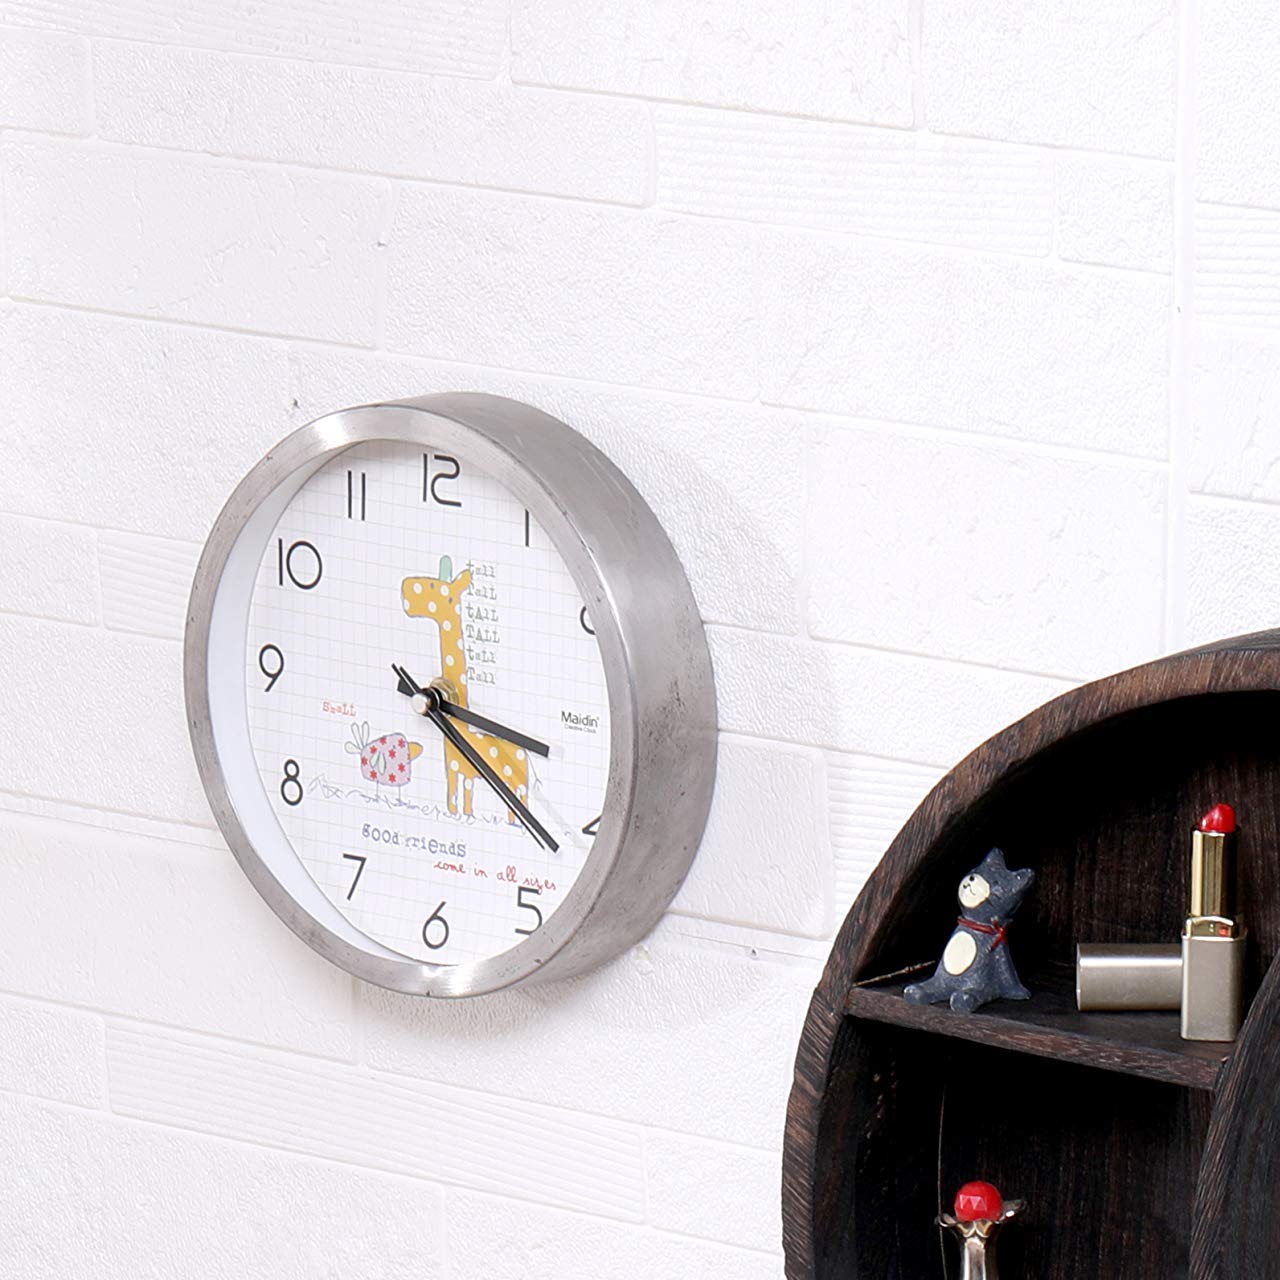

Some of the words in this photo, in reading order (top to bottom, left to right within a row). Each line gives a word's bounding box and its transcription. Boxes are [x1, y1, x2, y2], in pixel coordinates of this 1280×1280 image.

[347, 470, 366, 521] 11
[422, 453, 462, 507] 12
[278, 538, 323, 590] 10
[259, 644, 285, 692] 9
[561, 710, 598, 728] Maidin
[280, 759, 303, 806] 8
[342, 853, 367, 901] 7
[422, 901, 449, 950] 6
[515, 886, 543, 935] 5
